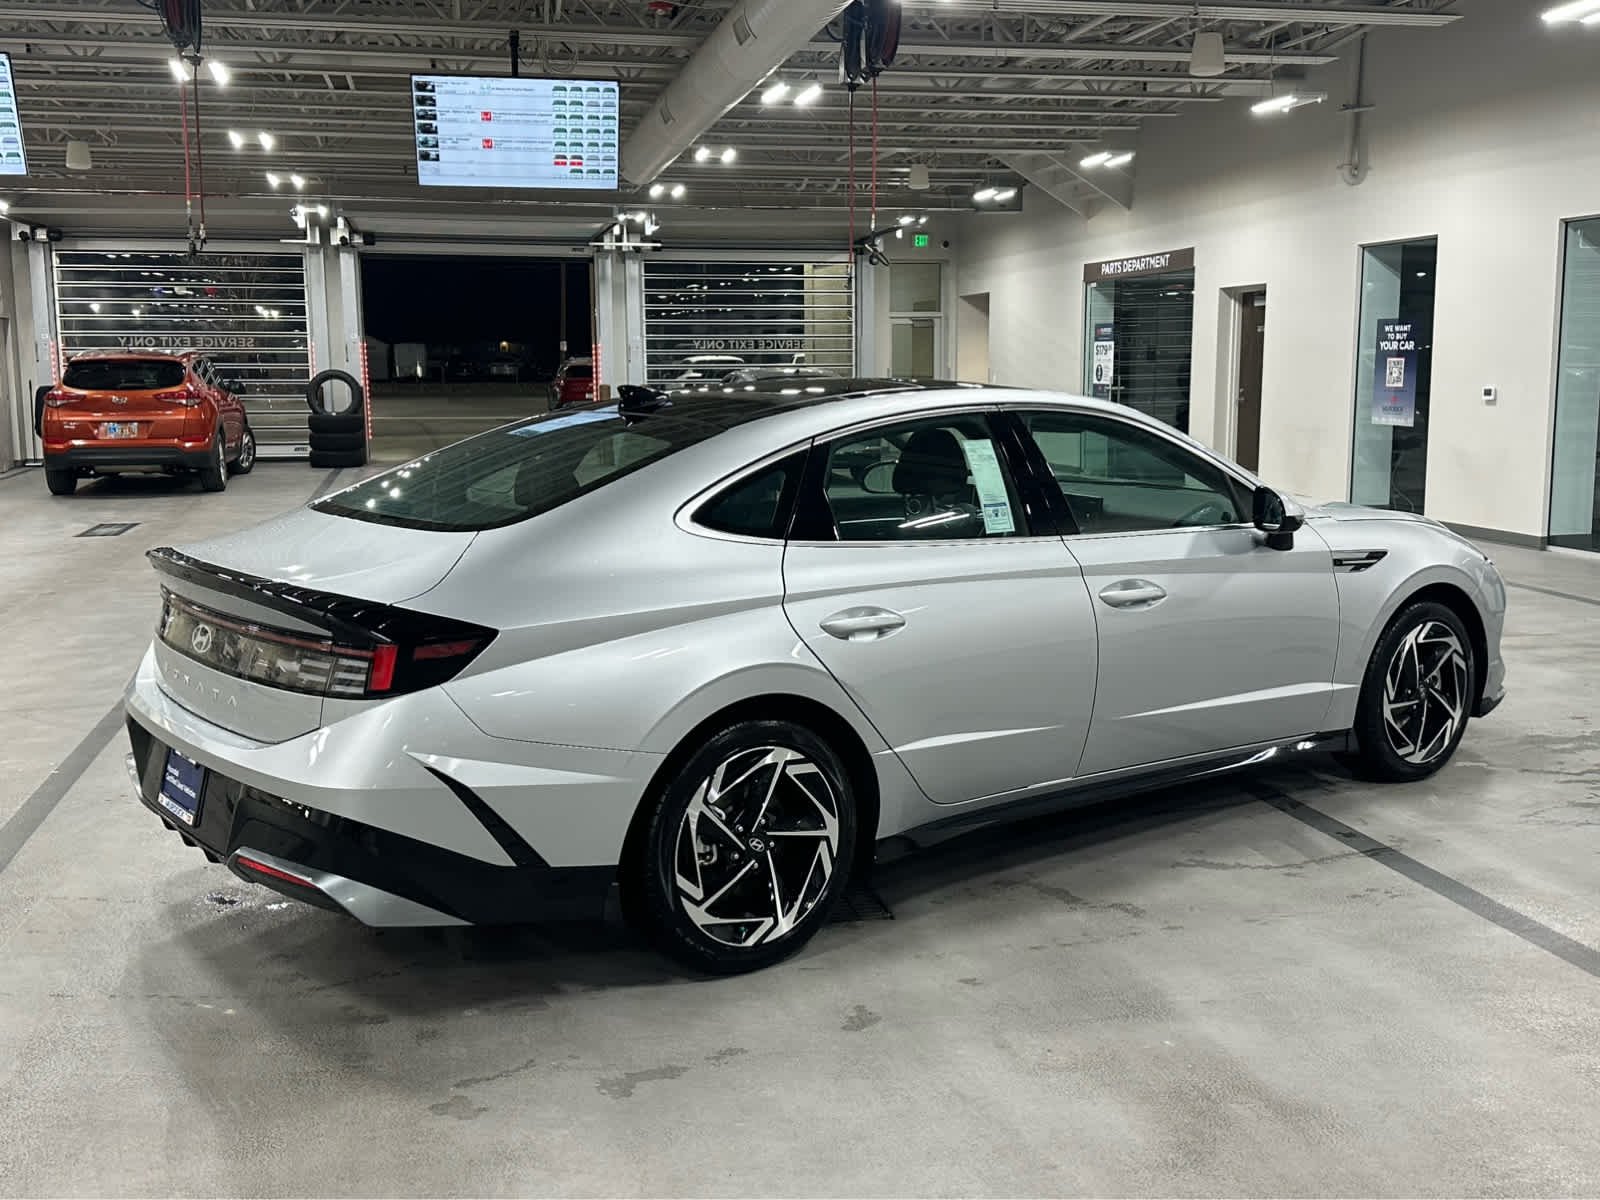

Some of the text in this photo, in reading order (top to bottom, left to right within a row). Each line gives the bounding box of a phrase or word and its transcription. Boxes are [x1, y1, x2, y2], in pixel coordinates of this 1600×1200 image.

[1101, 254, 1171, 275] PARTS DEPARTMENT
[1384, 324, 1412, 332] WE WANT
[1380, 340, 1415, 351] YOUR CAR
